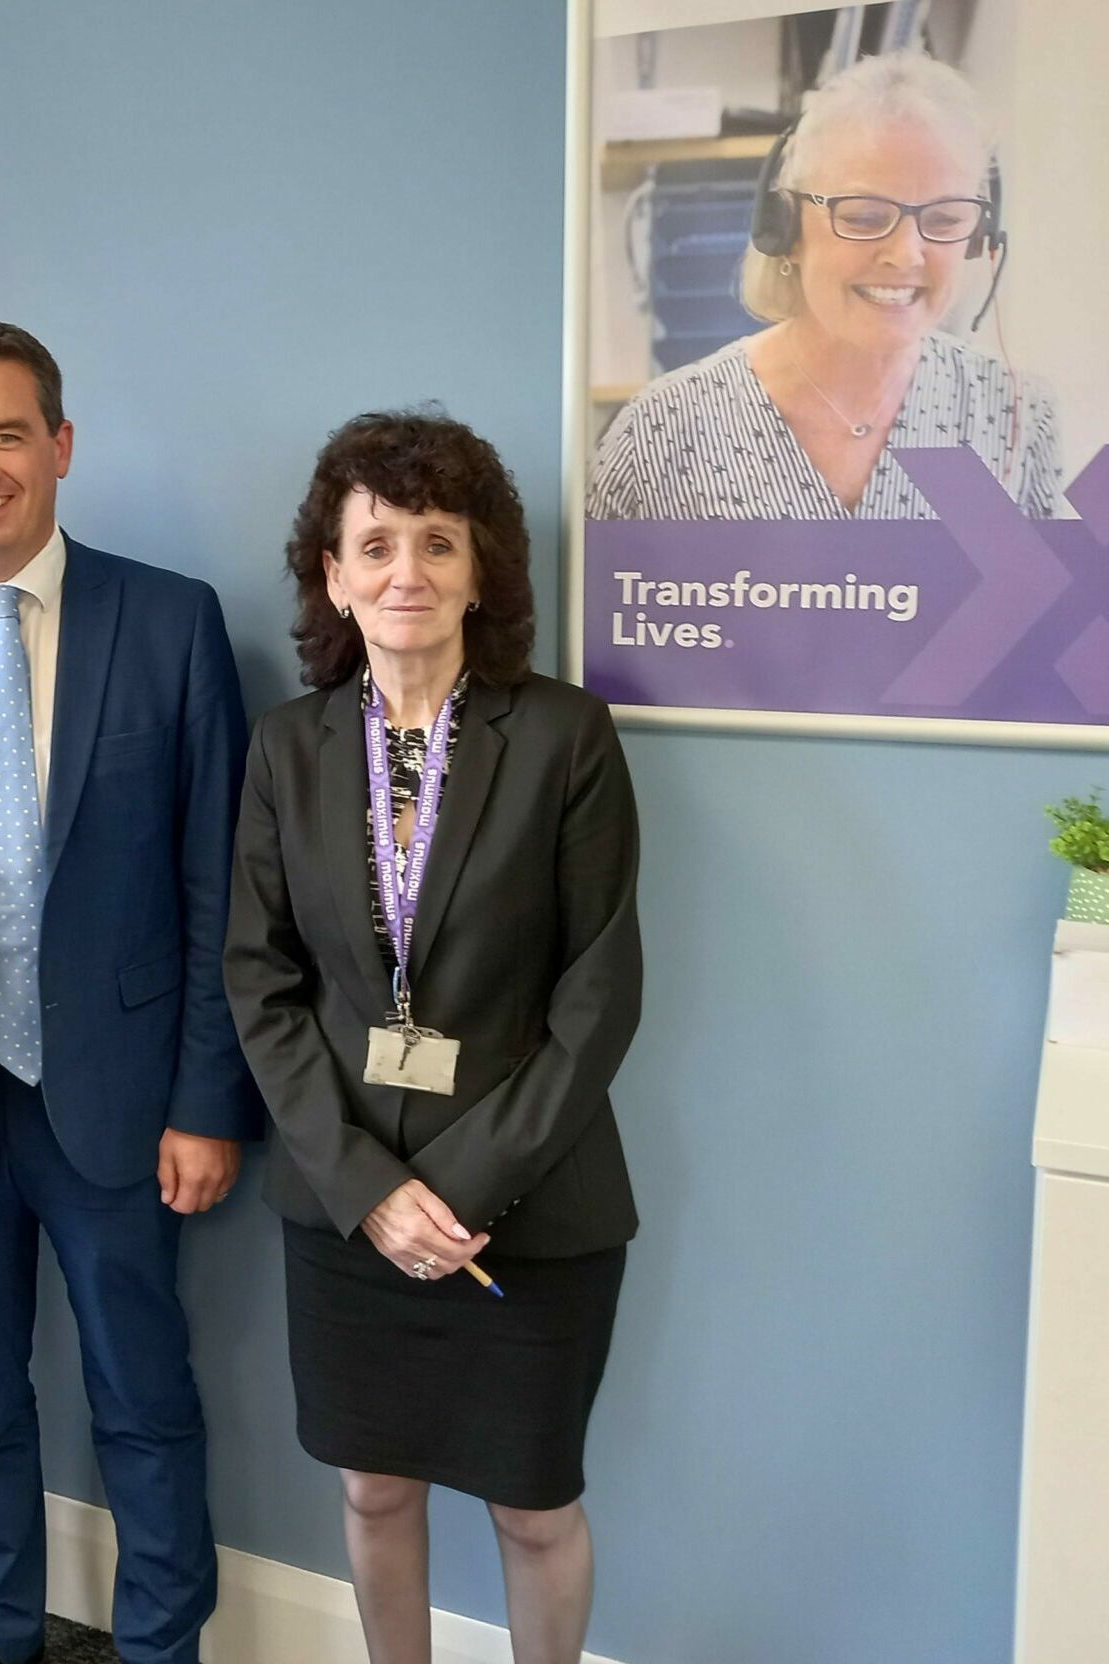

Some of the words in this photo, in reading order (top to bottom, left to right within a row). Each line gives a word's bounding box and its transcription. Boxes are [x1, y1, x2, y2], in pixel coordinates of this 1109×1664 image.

[613, 570, 919, 621] Transforming
[612, 612, 735, 649] Lives.
[369, 717, 384, 775] maximus
[432, 698, 449, 754] maximu
[375, 788, 390, 847] maximus
[419, 768, 438, 827] maximus
[381, 861, 396, 921] maximus
[406, 842, 426, 901] maximus
